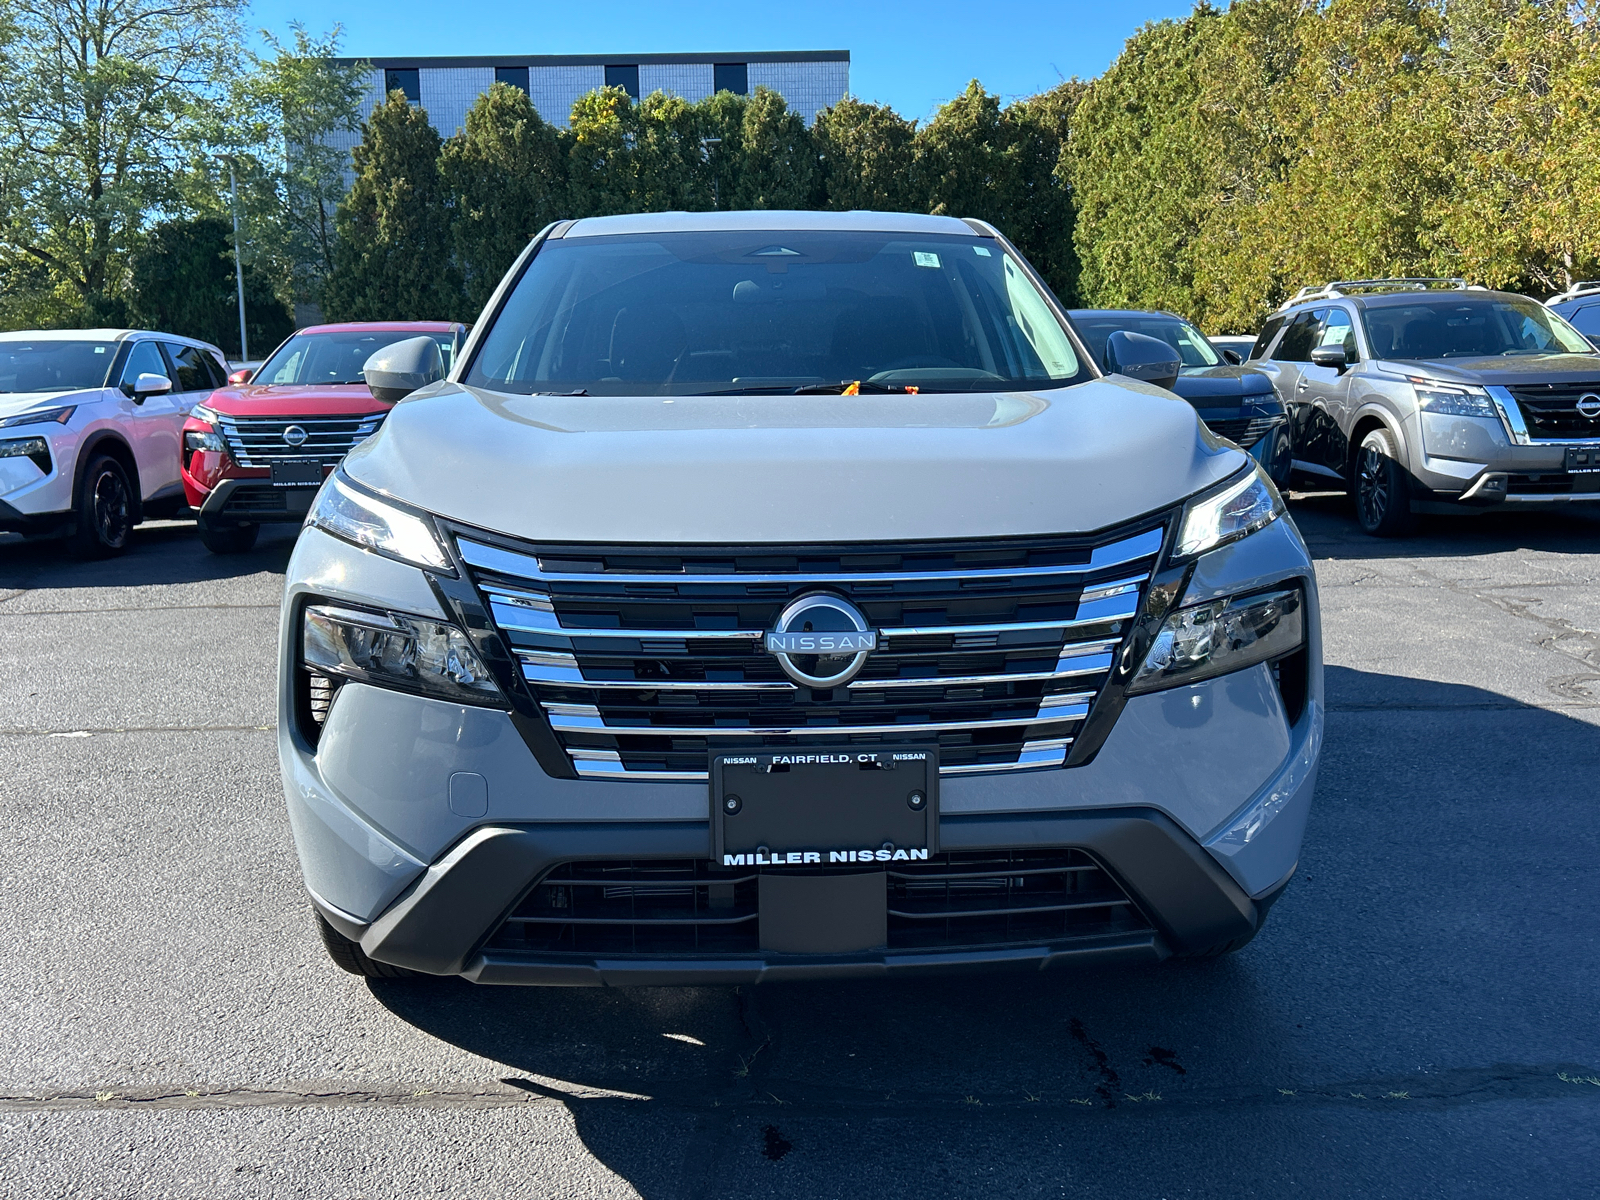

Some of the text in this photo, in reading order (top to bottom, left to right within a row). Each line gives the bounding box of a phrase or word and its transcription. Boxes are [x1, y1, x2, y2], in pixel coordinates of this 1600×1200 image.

[770, 635, 874, 651] NISSAN
[723, 757, 757, 765] NISSAN
[772, 753, 878, 765] FAIRFIELD, CT
[892, 753, 926, 761] NISSAN
[723, 848, 929, 867] MILLER NISSAN
